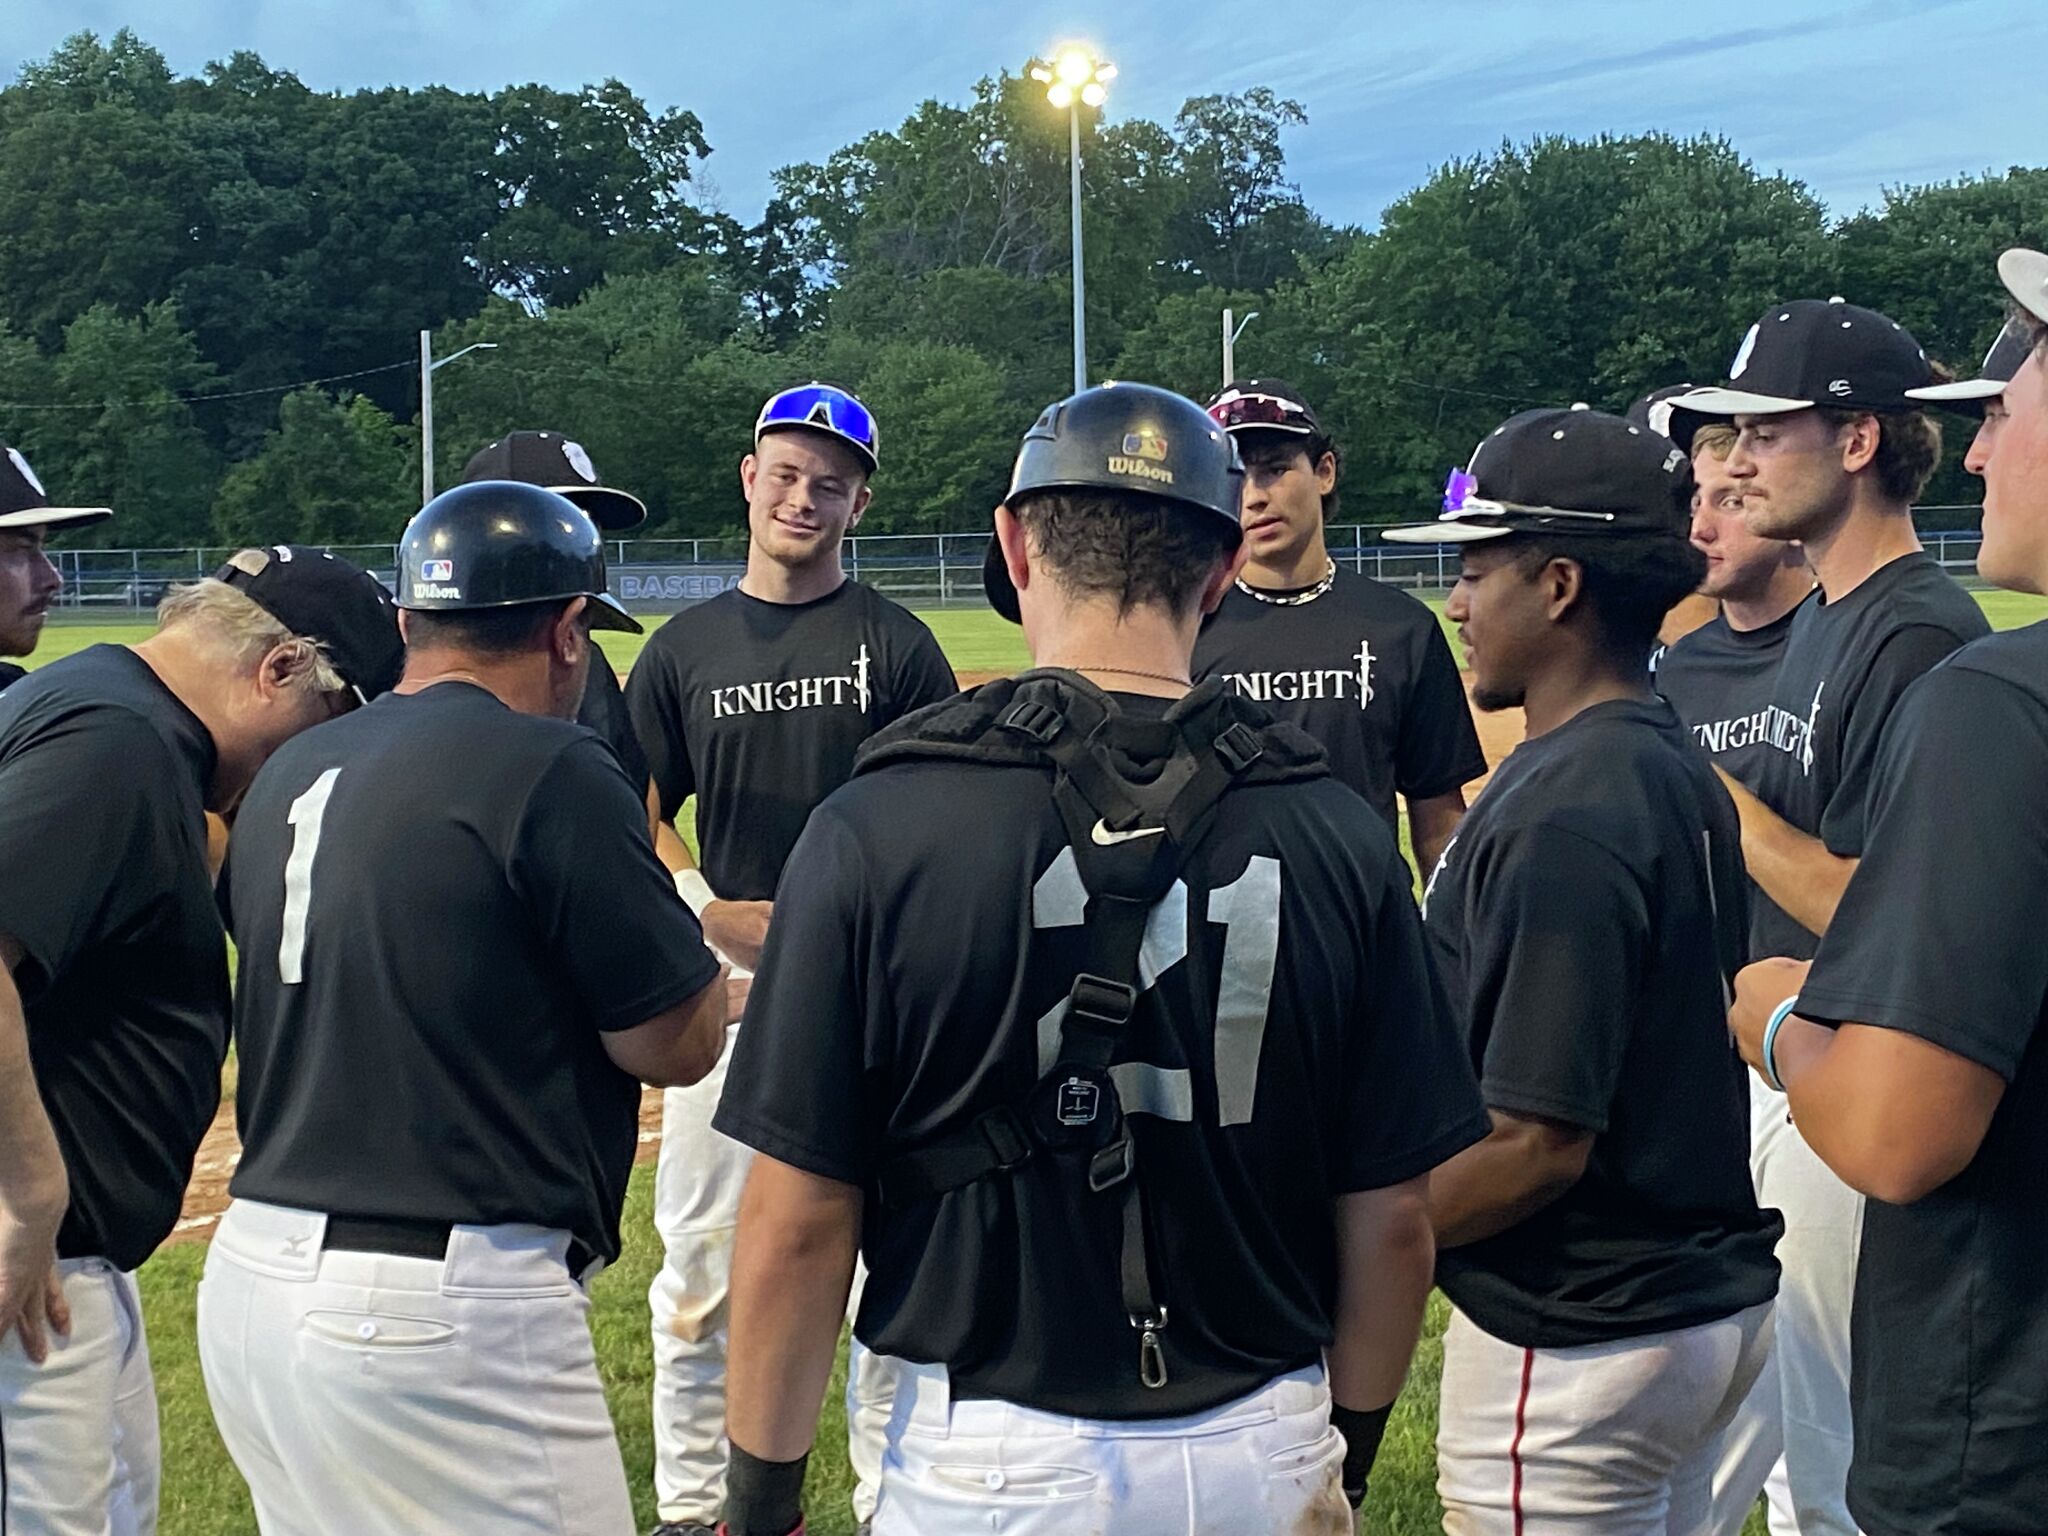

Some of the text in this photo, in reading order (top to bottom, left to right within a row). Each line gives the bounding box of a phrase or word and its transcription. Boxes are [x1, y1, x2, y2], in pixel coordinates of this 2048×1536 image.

[1108, 456, 1174, 484] Wilson
[413, 583, 461, 599] Wilson
[711, 673, 873, 719] KNIGHTS
[278, 767, 343, 985] 1
